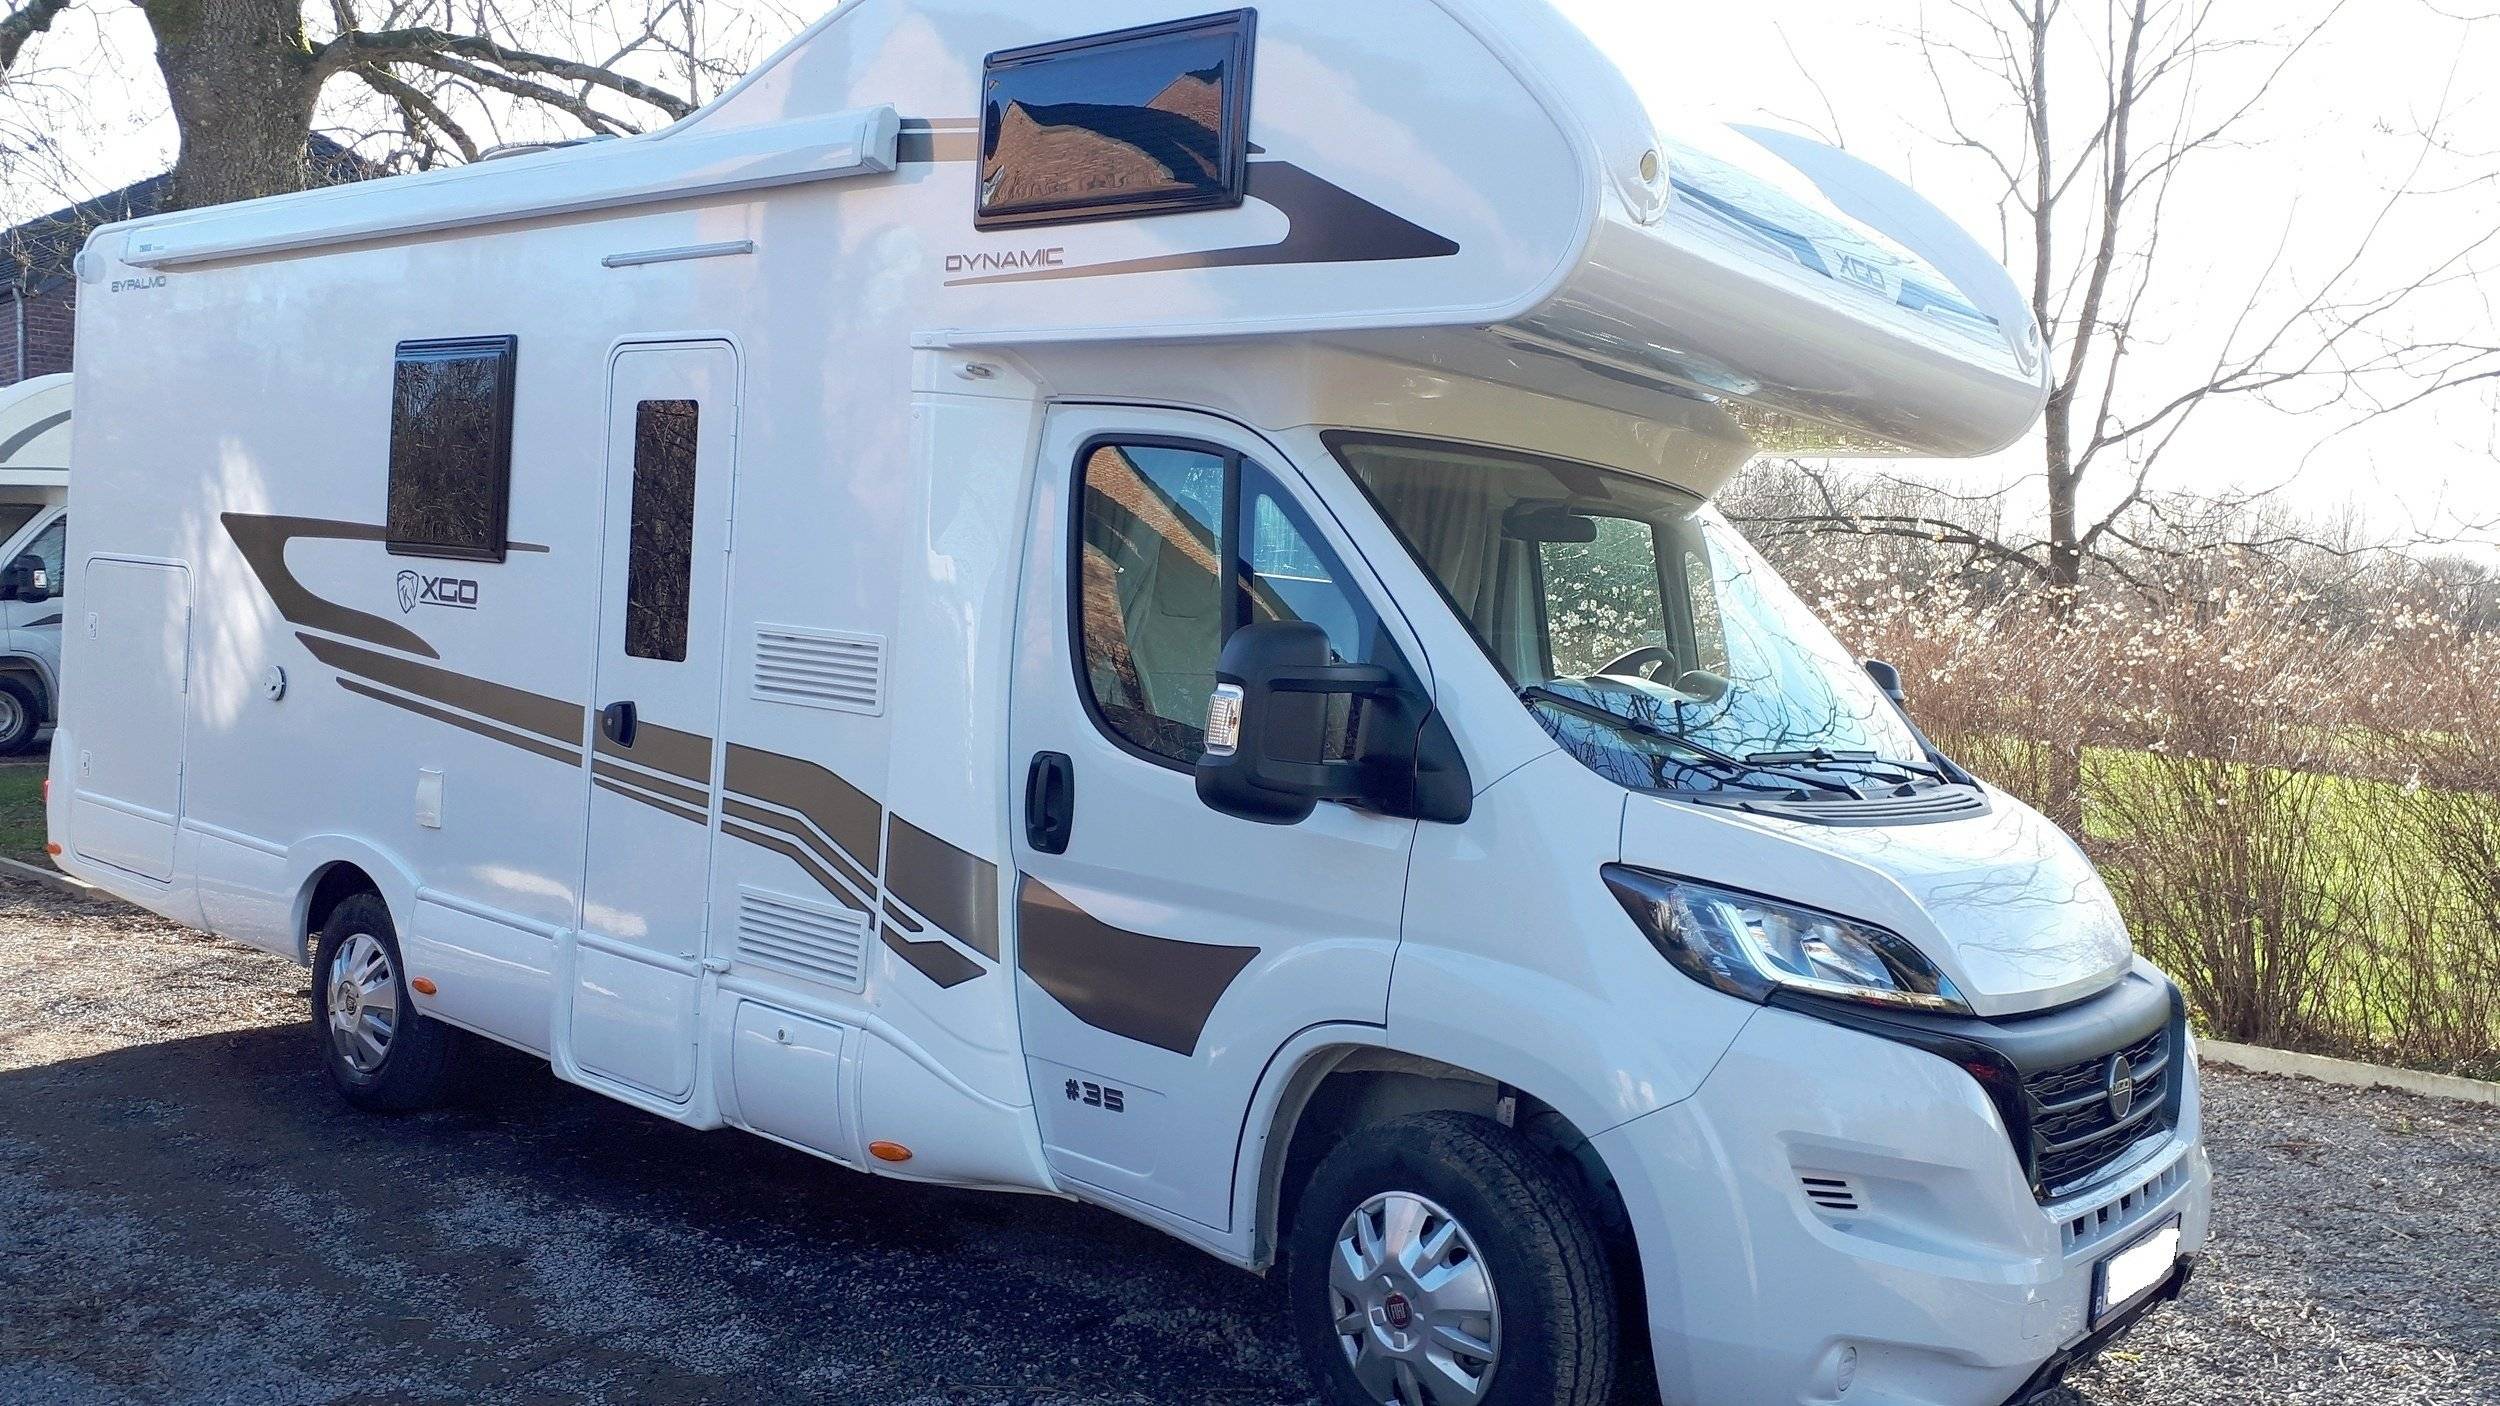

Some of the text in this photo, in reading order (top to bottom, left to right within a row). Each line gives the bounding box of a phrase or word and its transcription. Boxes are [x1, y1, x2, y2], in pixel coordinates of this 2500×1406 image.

[945, 247, 1064, 271] DYNAMIC
[420, 575, 478, 604] XGO
[1065, 1078, 1124, 1113] #35
